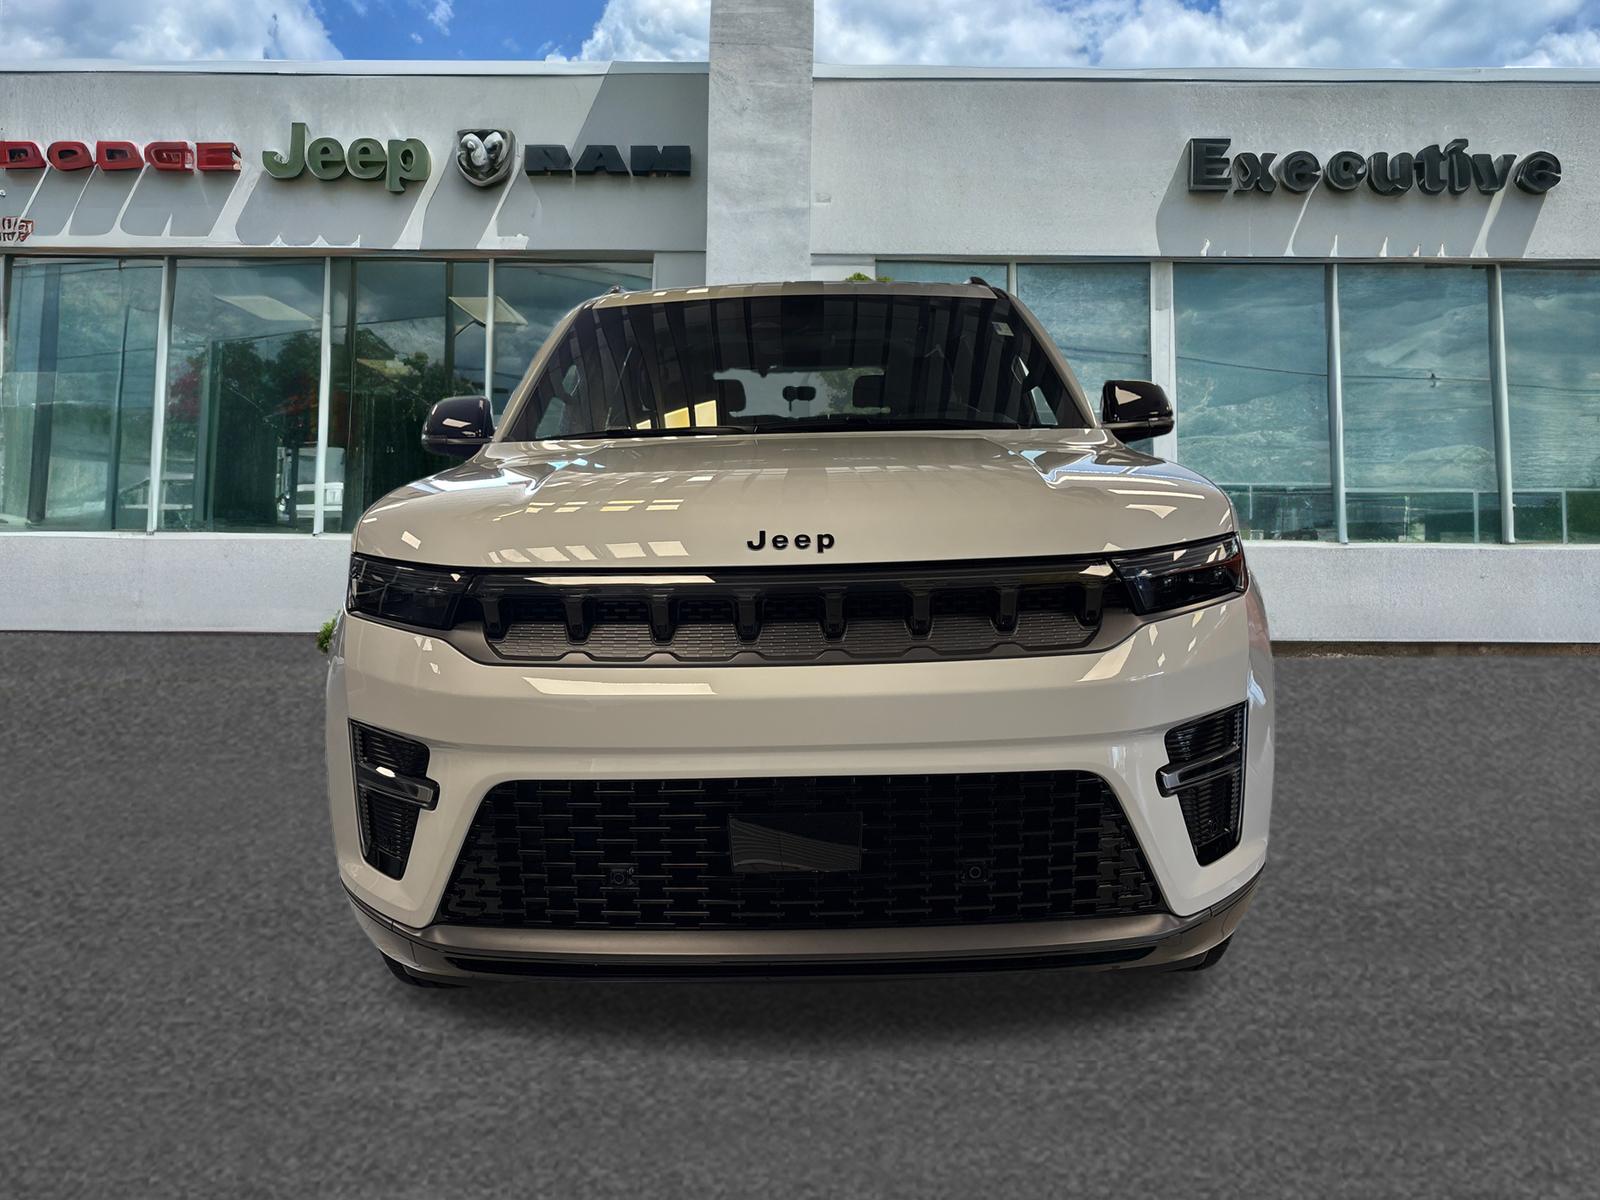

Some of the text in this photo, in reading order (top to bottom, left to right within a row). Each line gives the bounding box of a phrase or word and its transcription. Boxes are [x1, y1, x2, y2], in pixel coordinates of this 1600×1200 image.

[0, 141, 241, 172] DODGE
[262, 122, 431, 193] Jeep
[1188, 138, 1562, 195] Executive
[747, 530, 835, 553] Jeep
